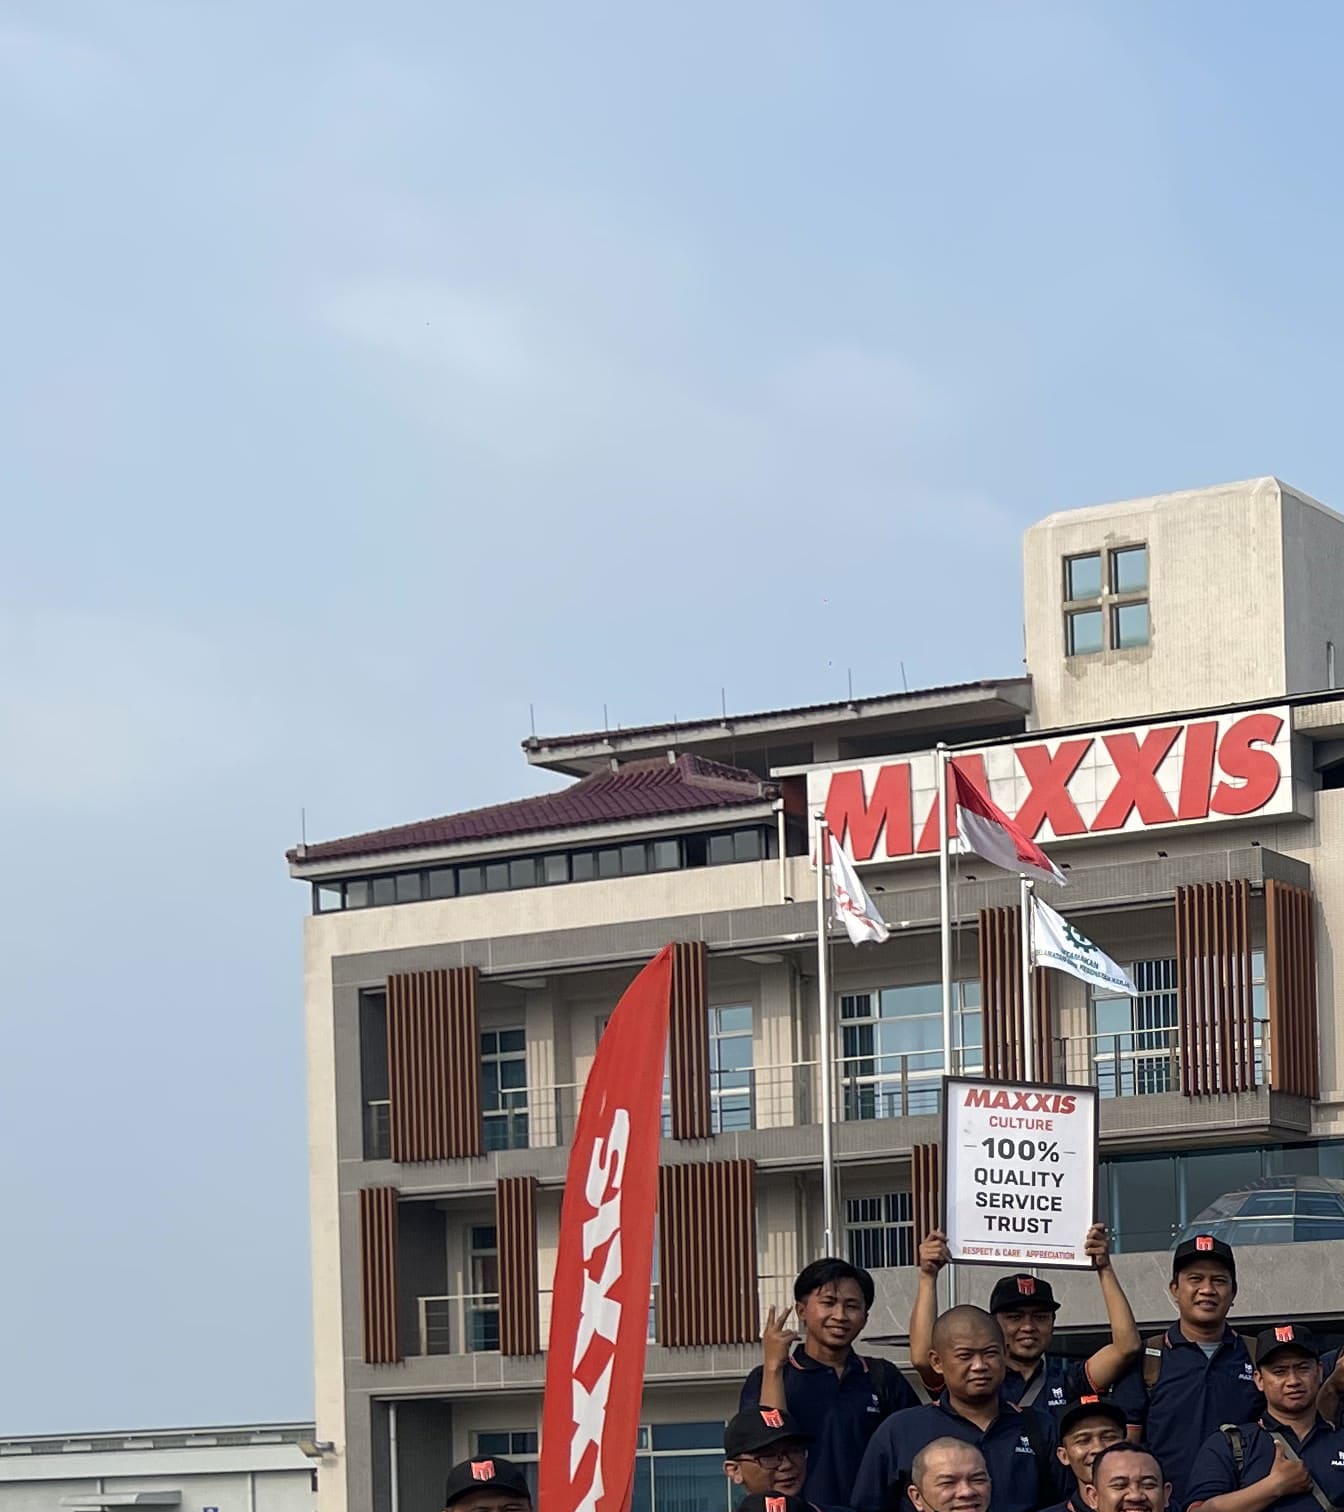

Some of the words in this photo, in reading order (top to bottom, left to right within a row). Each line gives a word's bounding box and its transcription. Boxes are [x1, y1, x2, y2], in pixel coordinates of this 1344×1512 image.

[814, 714, 1284, 866] MAXXIS
[964, 1089, 1076, 1114] MAXXIS
[989, 1116, 1053, 1131] CULTURE
[982, 1137, 1060, 1162] 100%
[974, 1168, 1065, 1188] QUALITY
[975, 1191, 1062, 1212] SERVICE
[984, 1215, 1053, 1234] TRUST
